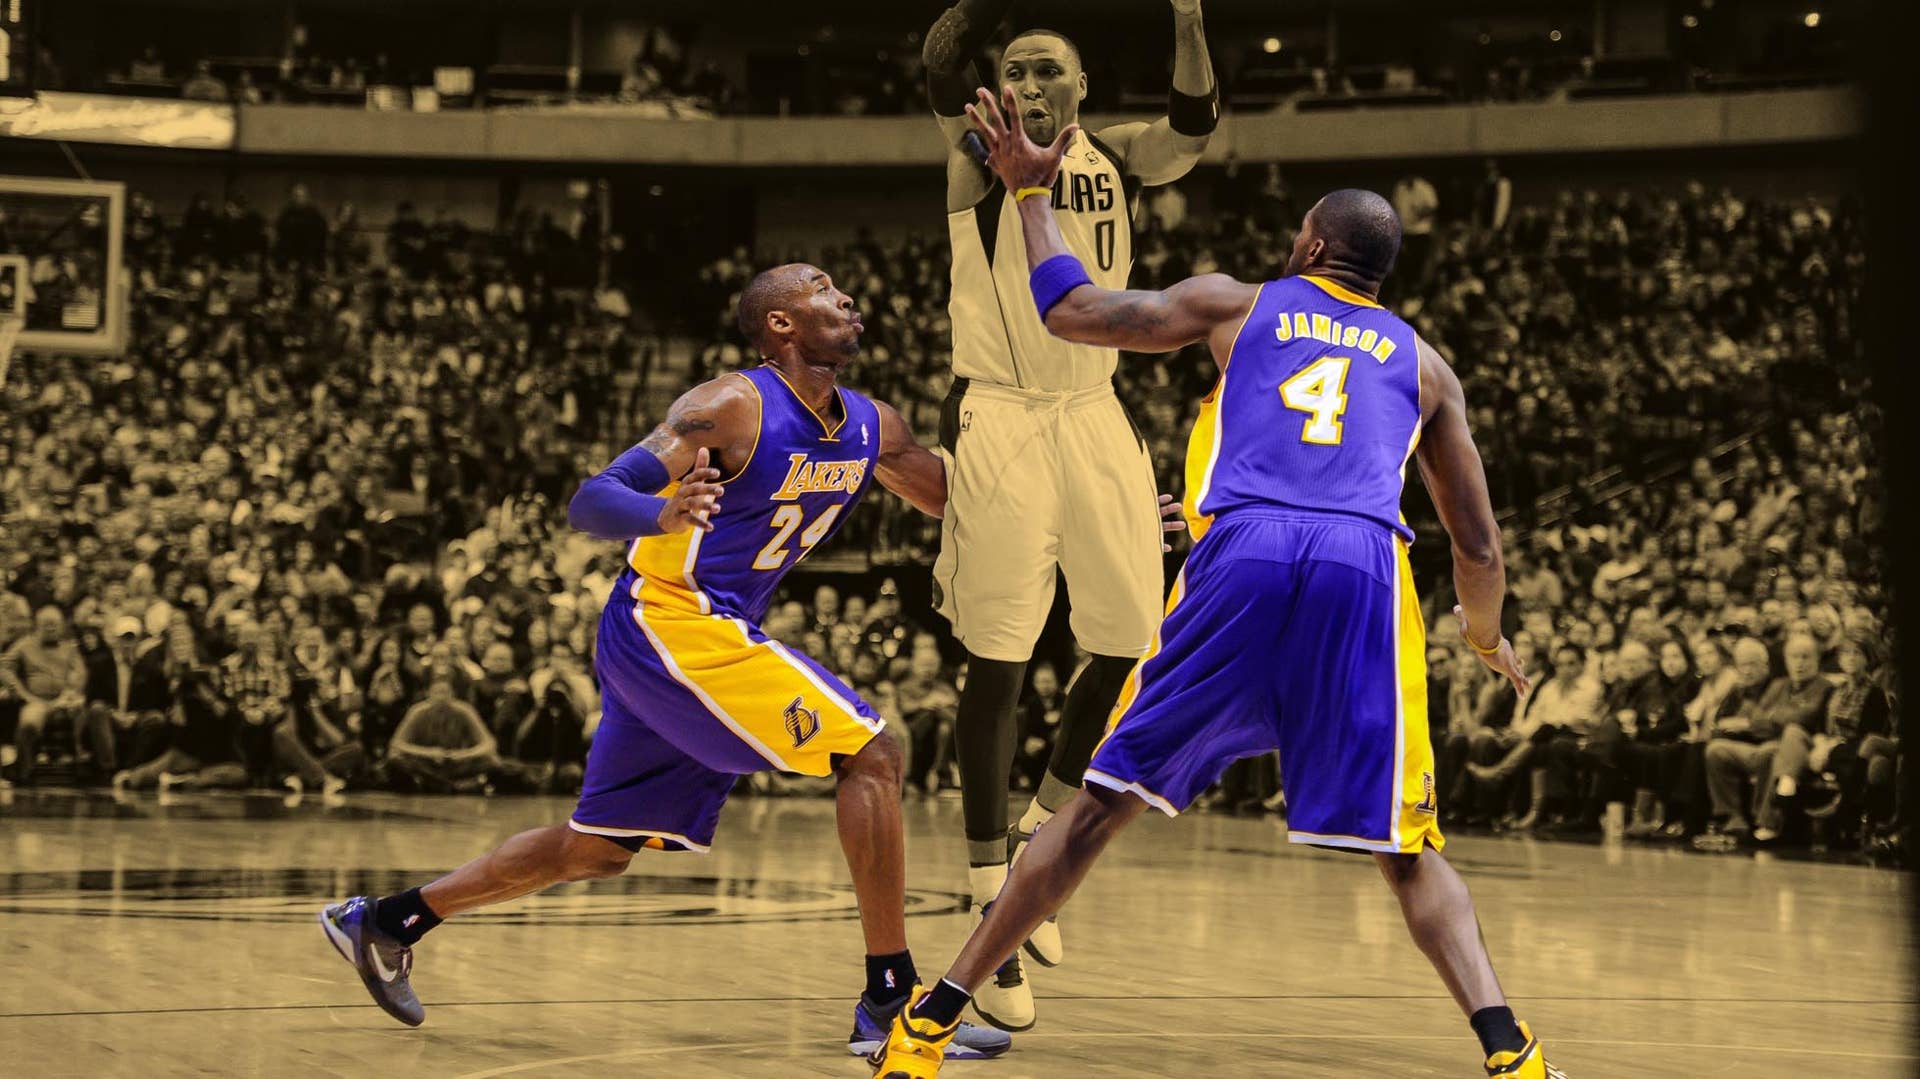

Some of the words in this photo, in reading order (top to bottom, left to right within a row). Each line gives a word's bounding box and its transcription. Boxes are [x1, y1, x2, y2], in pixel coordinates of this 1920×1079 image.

[1095, 219, 1115, 271] 0
[1275, 312, 1397, 364] JAMISON
[1278, 355, 1351, 445] 4
[770, 453, 869, 501] LAKERS
[752, 504, 843, 570] 24
